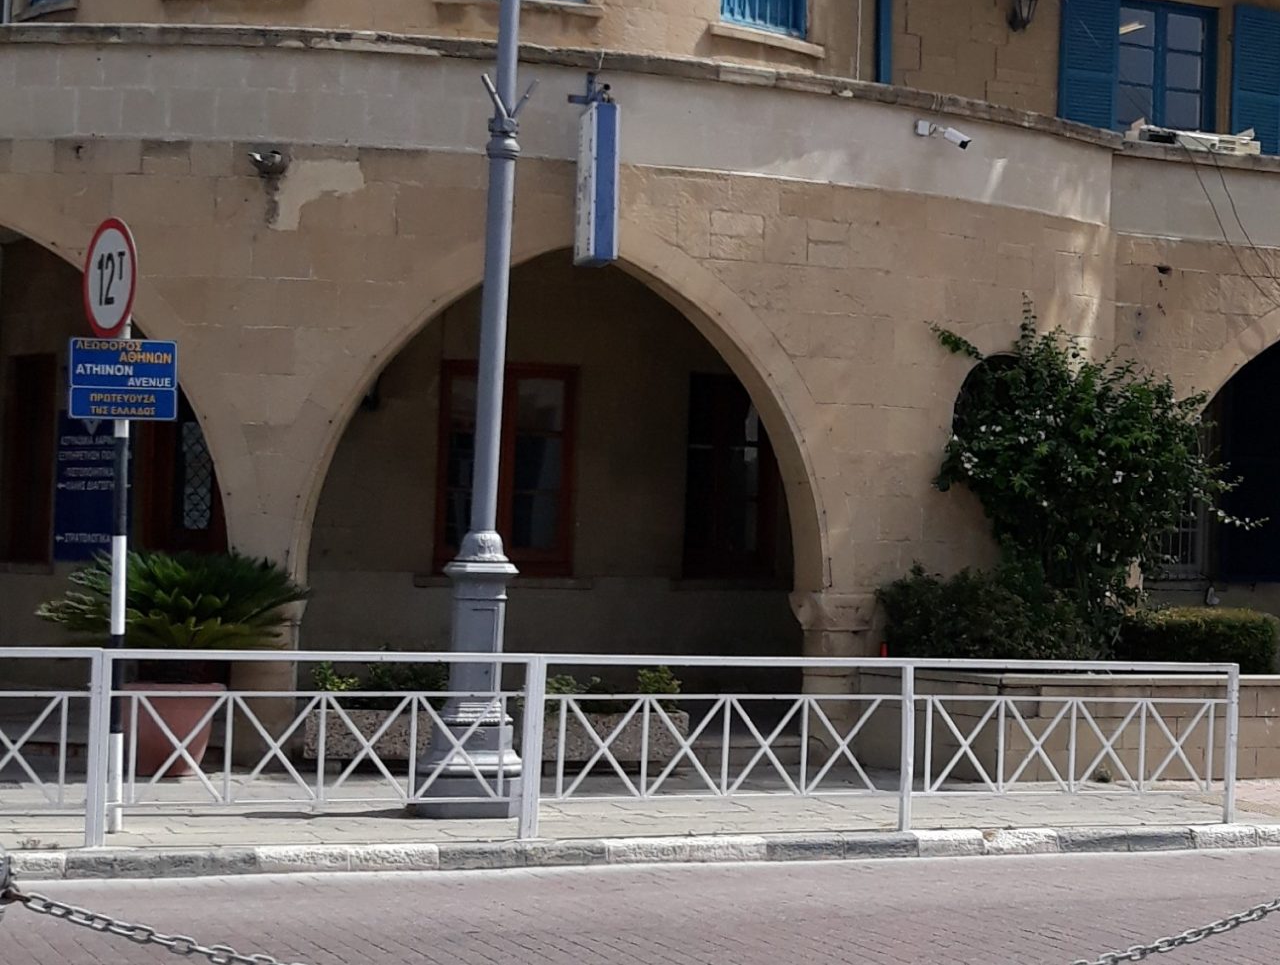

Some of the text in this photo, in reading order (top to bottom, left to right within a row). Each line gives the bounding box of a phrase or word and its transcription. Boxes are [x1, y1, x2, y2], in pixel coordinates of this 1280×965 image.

[76, 340, 143, 352] ΛΕΩΦΟΡΟΣ
[119, 352, 172, 364] ΑΘΗΝΩΝ
[76, 364, 134, 376] ATHINON
[127, 377, 172, 387] AVENUE
